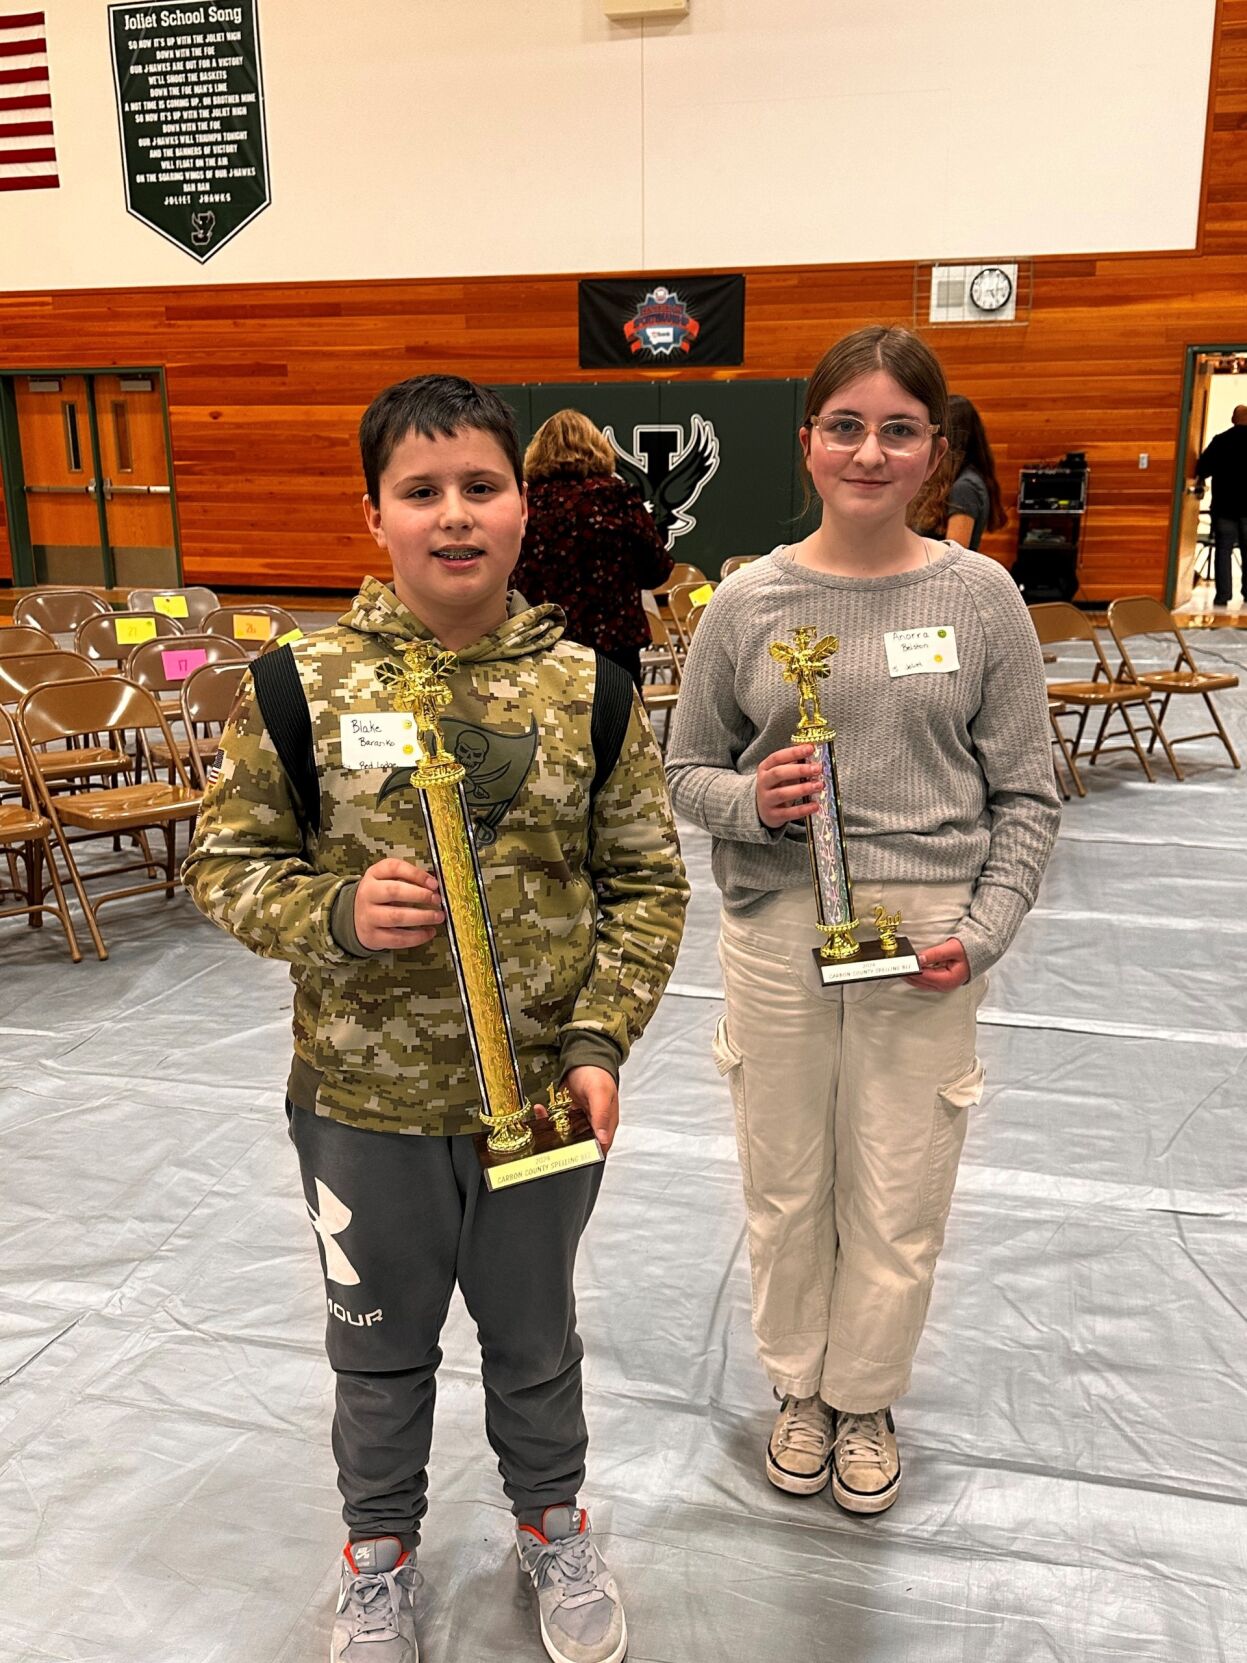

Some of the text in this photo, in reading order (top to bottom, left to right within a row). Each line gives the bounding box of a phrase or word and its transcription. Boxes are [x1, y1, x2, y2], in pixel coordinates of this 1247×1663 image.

[124, 6, 241, 30] Joliet School Song
[128, 32, 241, 49] SO NOW IT'S UP WITH THE JOLIET HIGH
[157, 47, 215, 59] DOWN WITH THE FOE
[130, 65, 142, 74] OUR
[173, 62, 184, 70] ARE
[186, 61, 196, 69] OUT
[199, 60, 210, 68] FOR
[212, 59, 216, 67] A
[218, 57, 243, 66] VICTORY
[148, 71, 227, 85] WE'LL SHOOT THE BASKETS
[150, 88, 167, 97] DOWN
[169, 87, 180, 95] THE
[182, 86, 192, 94] FOE
[215, 83, 227, 92] LINE
[131, 102, 141, 110] HOT
[143, 100, 157, 109] TIME
[159, 100, 164, 108] IS
[167, 98, 189, 107] COMING
[213, 94, 239, 104] BROTHER
[241, 93, 256, 102] MINE
[135, 106, 247, 122] SO NOW IT'S UP WITH THE JOLIET HIGH
[163, 121, 221, 133] DOWN WITH THE FOE
[139, 138, 150, 147] OUR
[180, 135, 194, 144] WILL
[196, 132, 222, 142] TRIUMPH
[224, 131, 247, 140] TONIGHT
[150, 144, 238, 158] AND THE BANNERS OF VICTORY
[161, 157, 228, 169] WILL FLOAT ON THE AIR
[136, 175, 145, 183] ON
[146, 174, 156, 182] THE
[158, 172, 184, 181] SOARING
[185, 171, 204, 180] WINGS
[206, 170, 213, 179] OF
[215, 169, 227, 178] OUR
[164, 196, 191, 205] JOLIET
[893, 632, 929, 640] Anorra
[351, 720, 382, 733] Blake
[497, 1171, 523, 1183] CARBON
[525, 1164, 549, 1176] COUNTY
[551, 1156, 578, 1169] SPELLING
